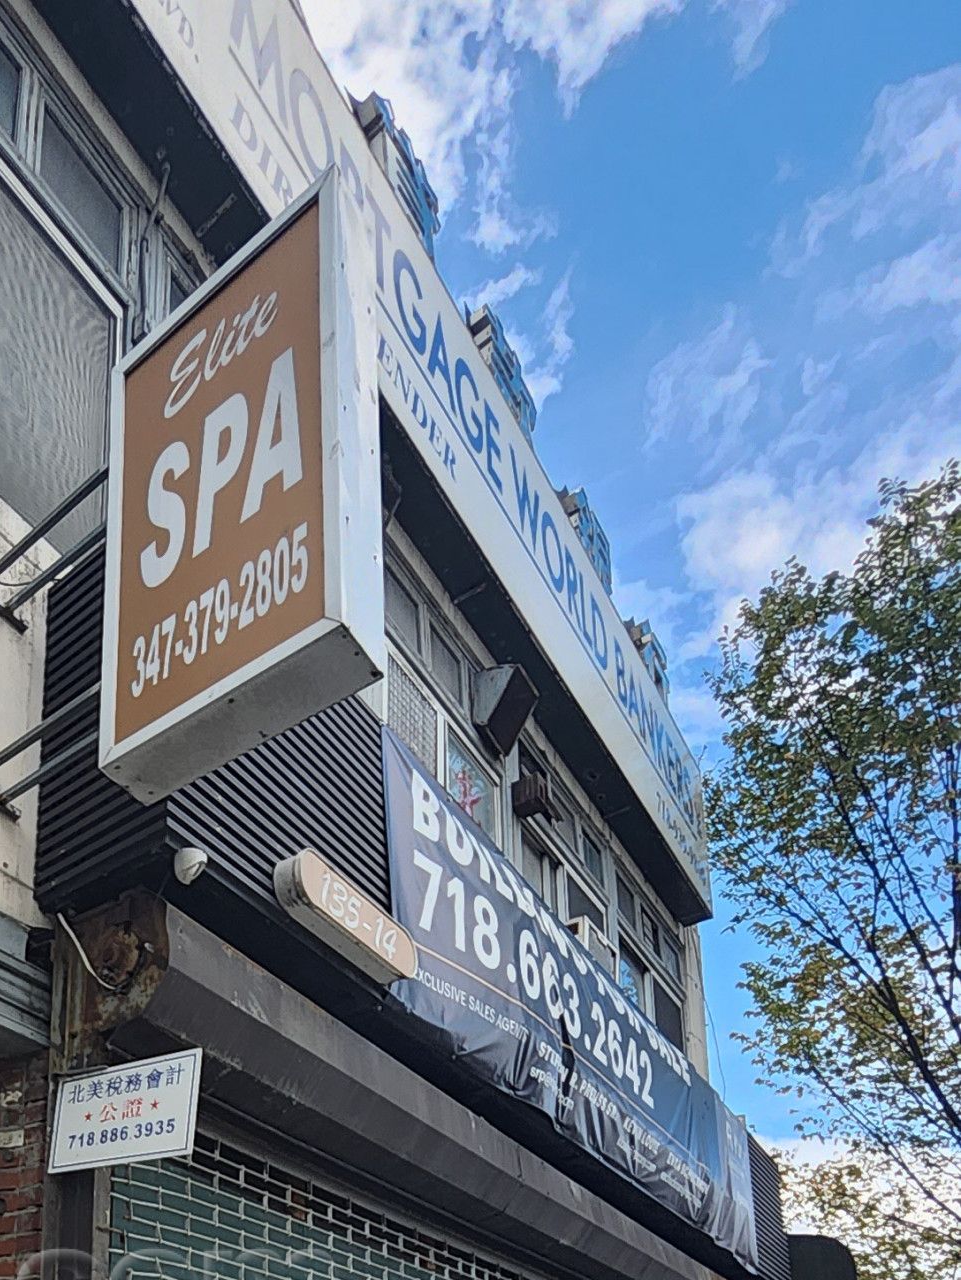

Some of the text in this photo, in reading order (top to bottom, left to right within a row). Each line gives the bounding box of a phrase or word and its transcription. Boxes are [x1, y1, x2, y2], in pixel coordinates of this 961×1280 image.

[163, 290, 279, 419] Elite
[377, 331, 458, 483] ENDER
[140, 346, 303, 588] SPA
[131, 522, 309, 699] 347-379-2805
[509, 442, 608, 671] WORLD
[321, 872, 398, 960] 135-14
[413, 848, 654, 1109] 718.663.2642
[414, 967, 468, 1007] EXCLUSIVE
[468, 995, 496, 1025] SALES
[68, 1118, 176, 1149] 718.886.3935
